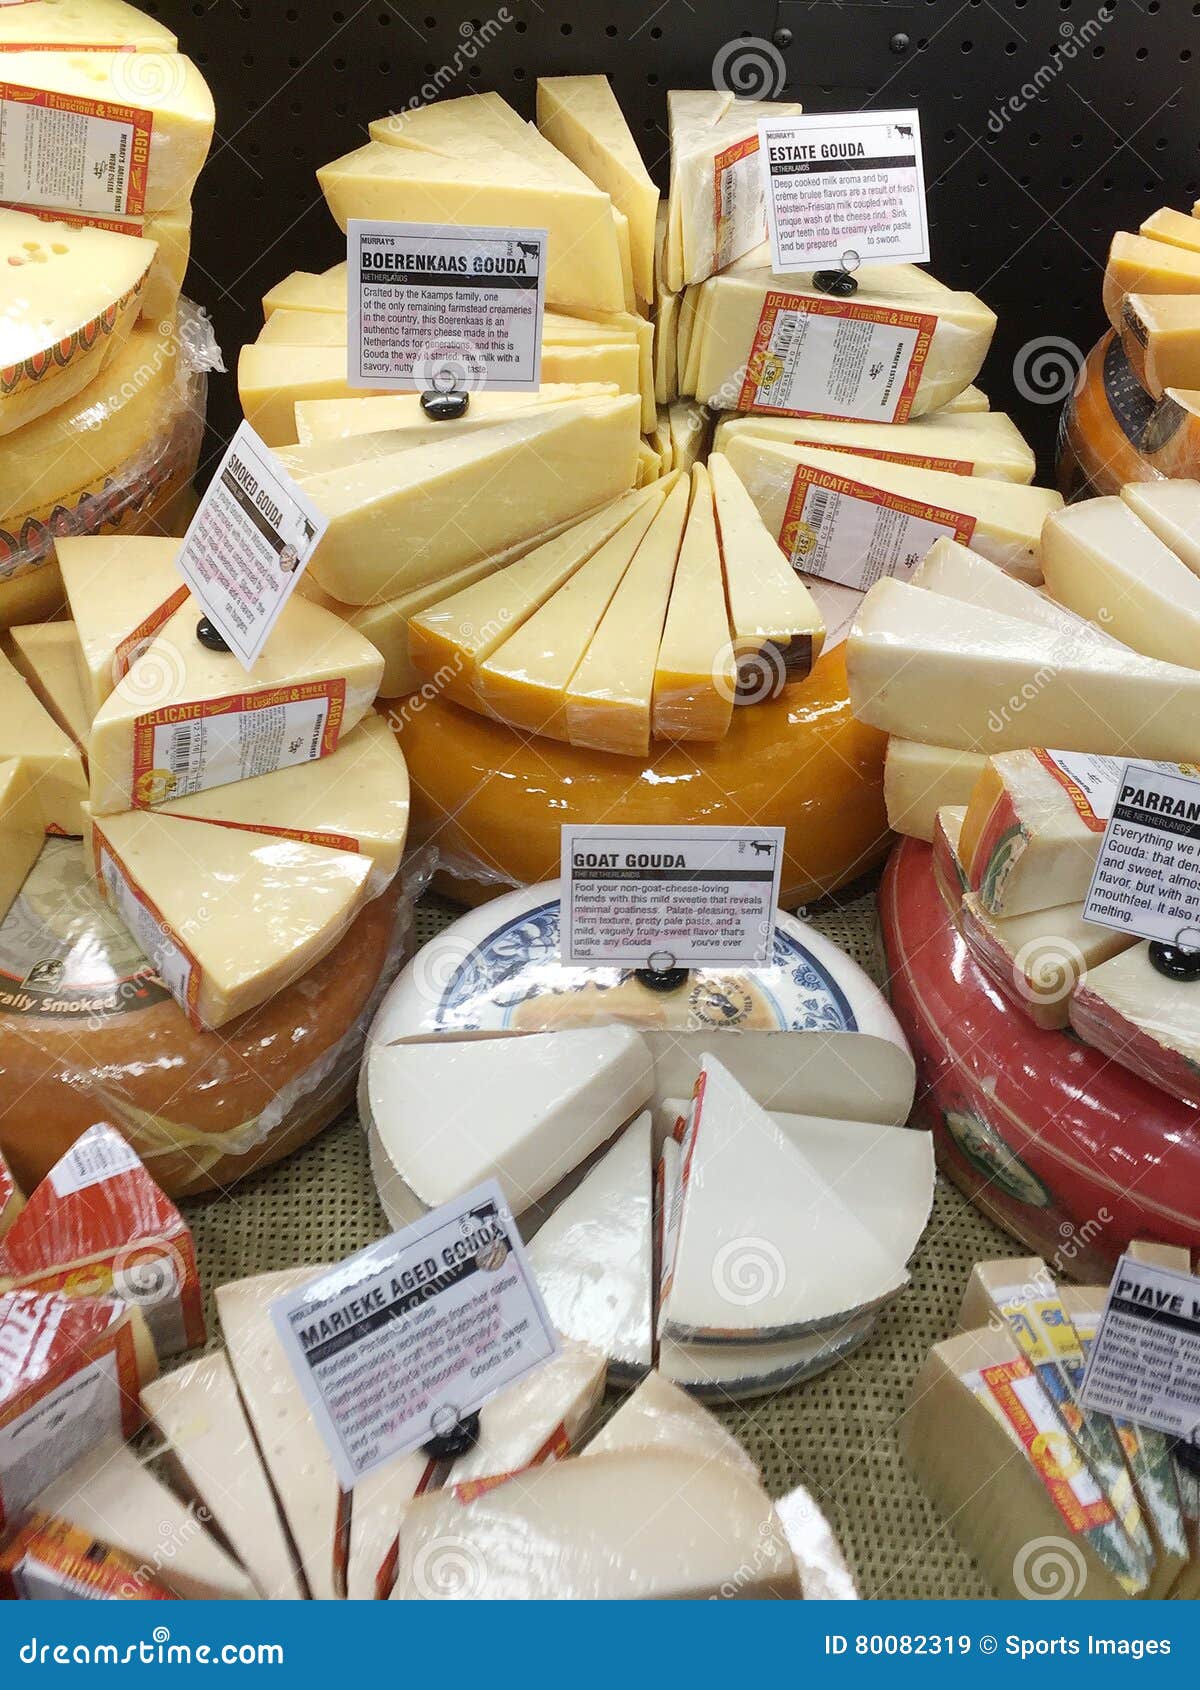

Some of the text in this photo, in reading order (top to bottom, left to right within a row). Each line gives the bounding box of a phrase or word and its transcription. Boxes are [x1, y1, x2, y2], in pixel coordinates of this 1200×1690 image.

[96, 105, 105, 116] &
[108, 105, 134, 117] SWEET
[134, 128, 148, 163] AGED
[769, 142, 865, 160] ESTATE GOUDA
[771, 164, 809, 172] NETHERLANDS
[774, 179, 792, 189] Deep
[794, 177, 820, 186] cooked
[822, 176, 835, 184] milk
[862, 174, 875, 182] and
[877, 173, 888, 183] big
[823, 188, 847, 197] flavors
[868, 186, 887, 194] result
[897, 184, 914, 193] fresh
[777, 197, 896, 213] Holstein-Friesian milk coupled with
[778, 209, 906, 227] unique wash the cheese Sink
[779, 222, 911, 239] your teeth into its creamy yellow paste
[361, 237, 394, 245] MURRAY'S
[780, 239, 837, 251] and prepared
[362, 252, 526, 274] BOERENKAAS GOUDA
[362, 273, 407, 282] NETHERLANDS
[363, 287, 391, 296] Crafted
[406, 289, 418, 297] the
[421, 290, 452, 301] Kaamps
[455, 291, 481, 301] family,
[373, 301, 531, 314] the only remaining farmstead creameries
[768, 295, 818, 311] DELICATE
[387, 315, 419, 324] country,
[422, 315, 435, 323] this
[439, 316, 483, 325] Boerenkaas
[890, 313, 922, 323] & SWEET
[363, 326, 508, 338] authentic farmers cheese made the
[363, 338, 504, 350] Netherlands for and this
[914, 333, 930, 361] AGED
[363, 350, 388, 358] Gouda
[391, 351, 403, 359] the
[405, 353, 420, 361] way
[497, 354, 512, 362] with
[363, 363, 413, 372] savory, nutty
[799, 468, 850, 492] DELICATE
[227, 453, 259, 497] SMOKED
[255, 487, 284, 529] GOUDA
[925, 508, 932, 518] &
[935, 510, 959, 521] SWEET
[291, 684, 326, 700] & SWEET
[138, 705, 201, 726] DELICATE
[328, 698, 343, 726] AGED
[1068, 786, 1092, 817] AGED
[1116, 807, 1190, 832] THE NETHERLANDS
[1111, 823, 1174, 851] Everything
[573, 853, 686, 867] GOAT GOUDA
[1107, 838, 1174, 866] Gouda: that
[1102, 855, 1165, 881] and sweet,
[597, 885, 617, 893] your
[620, 884, 729, 893] non-goat-cheese-loving
[1098, 870, 1182, 901] flavor, but with
[575, 895, 605, 903] friends
[609, 895, 628, 903] with
[631, 895, 647, 903] this
[730, 896, 762, 904] reveals
[1094, 885, 1192, 921] mouthfeel. also
[1089, 900, 1135, 923] melting.
[40, 997, 116, 1012] Smoked
[298, 1219, 504, 1348] MARIEKE AGED GOUDA
[1115, 1280, 1184, 1313] PIAVE
